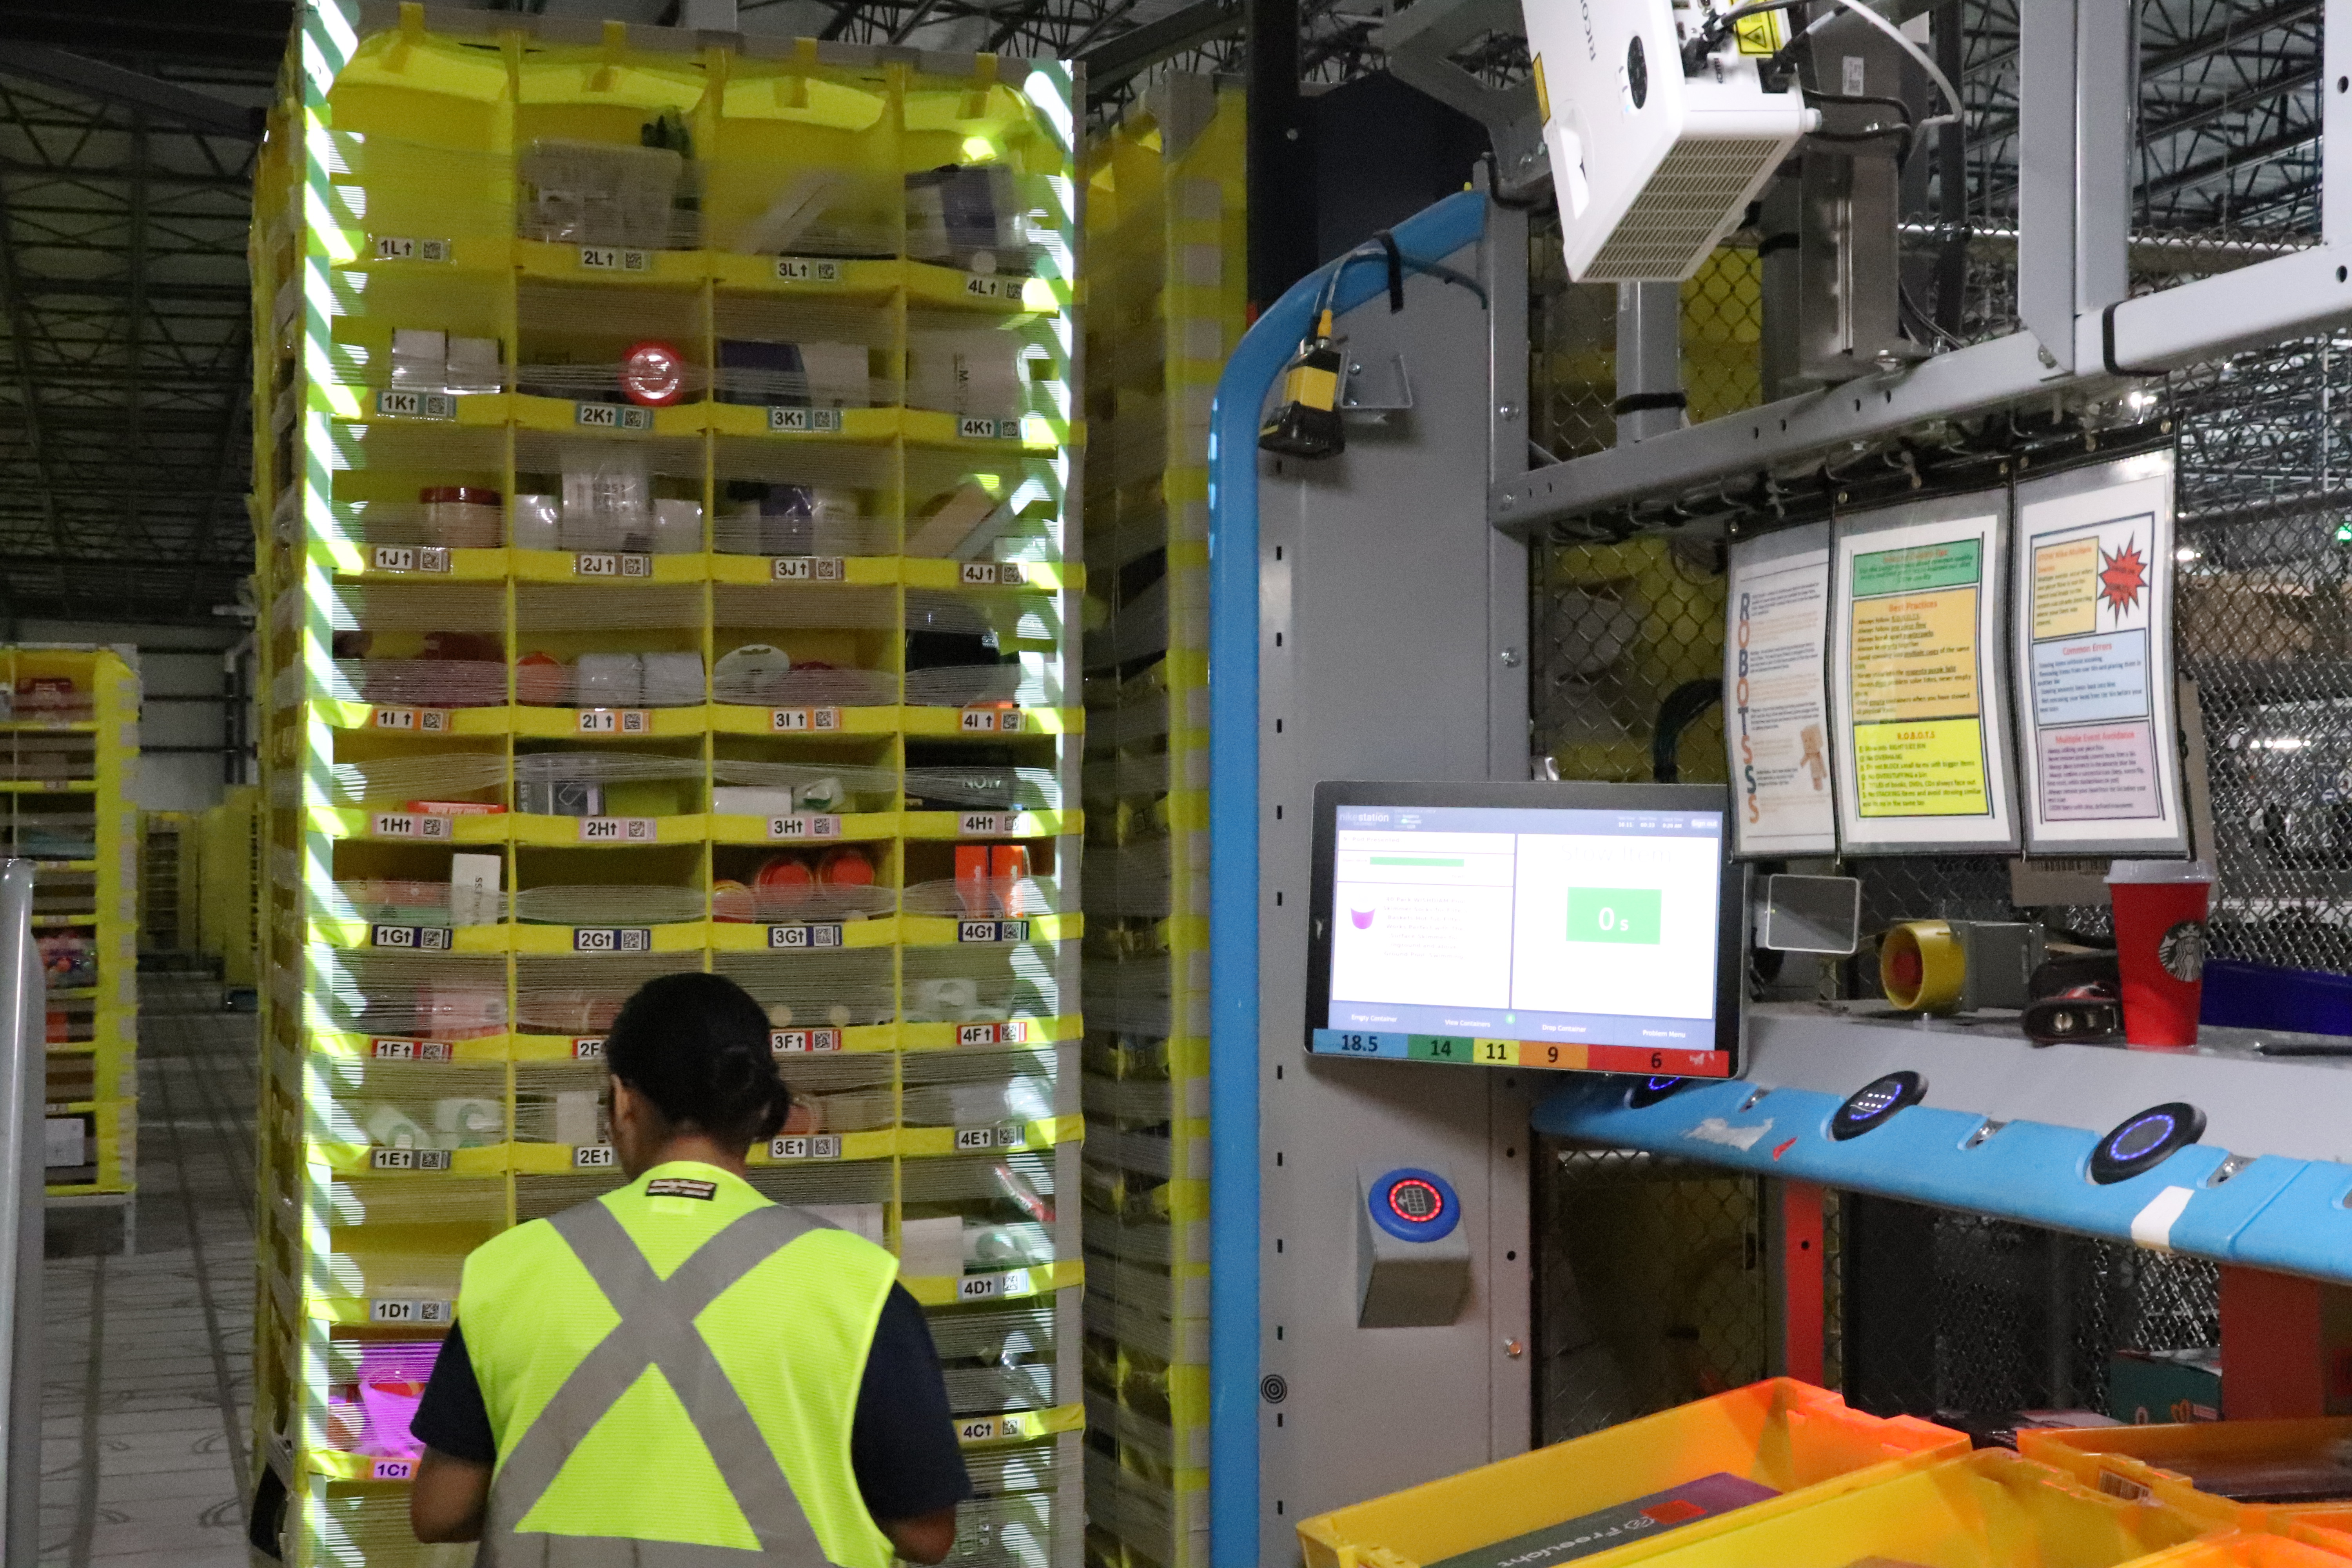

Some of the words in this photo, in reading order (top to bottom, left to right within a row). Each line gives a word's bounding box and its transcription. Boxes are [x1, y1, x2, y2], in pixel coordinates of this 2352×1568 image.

[2063, 646, 2091, 655] Common
[1561, 843, 1613, 862] Stow
[1623, 845, 1671, 862] Item
[1598, 907, 1615, 931] 0
[1620, 916, 1629, 931] s
[1341, 1034, 1378, 1052] 18.5
[1430, 1040, 1451, 1056] 14
[1486, 1043, 1507, 1060] 11
[1547, 1046, 1558, 1063] 9
[1651, 1052, 1662, 1068] 6
